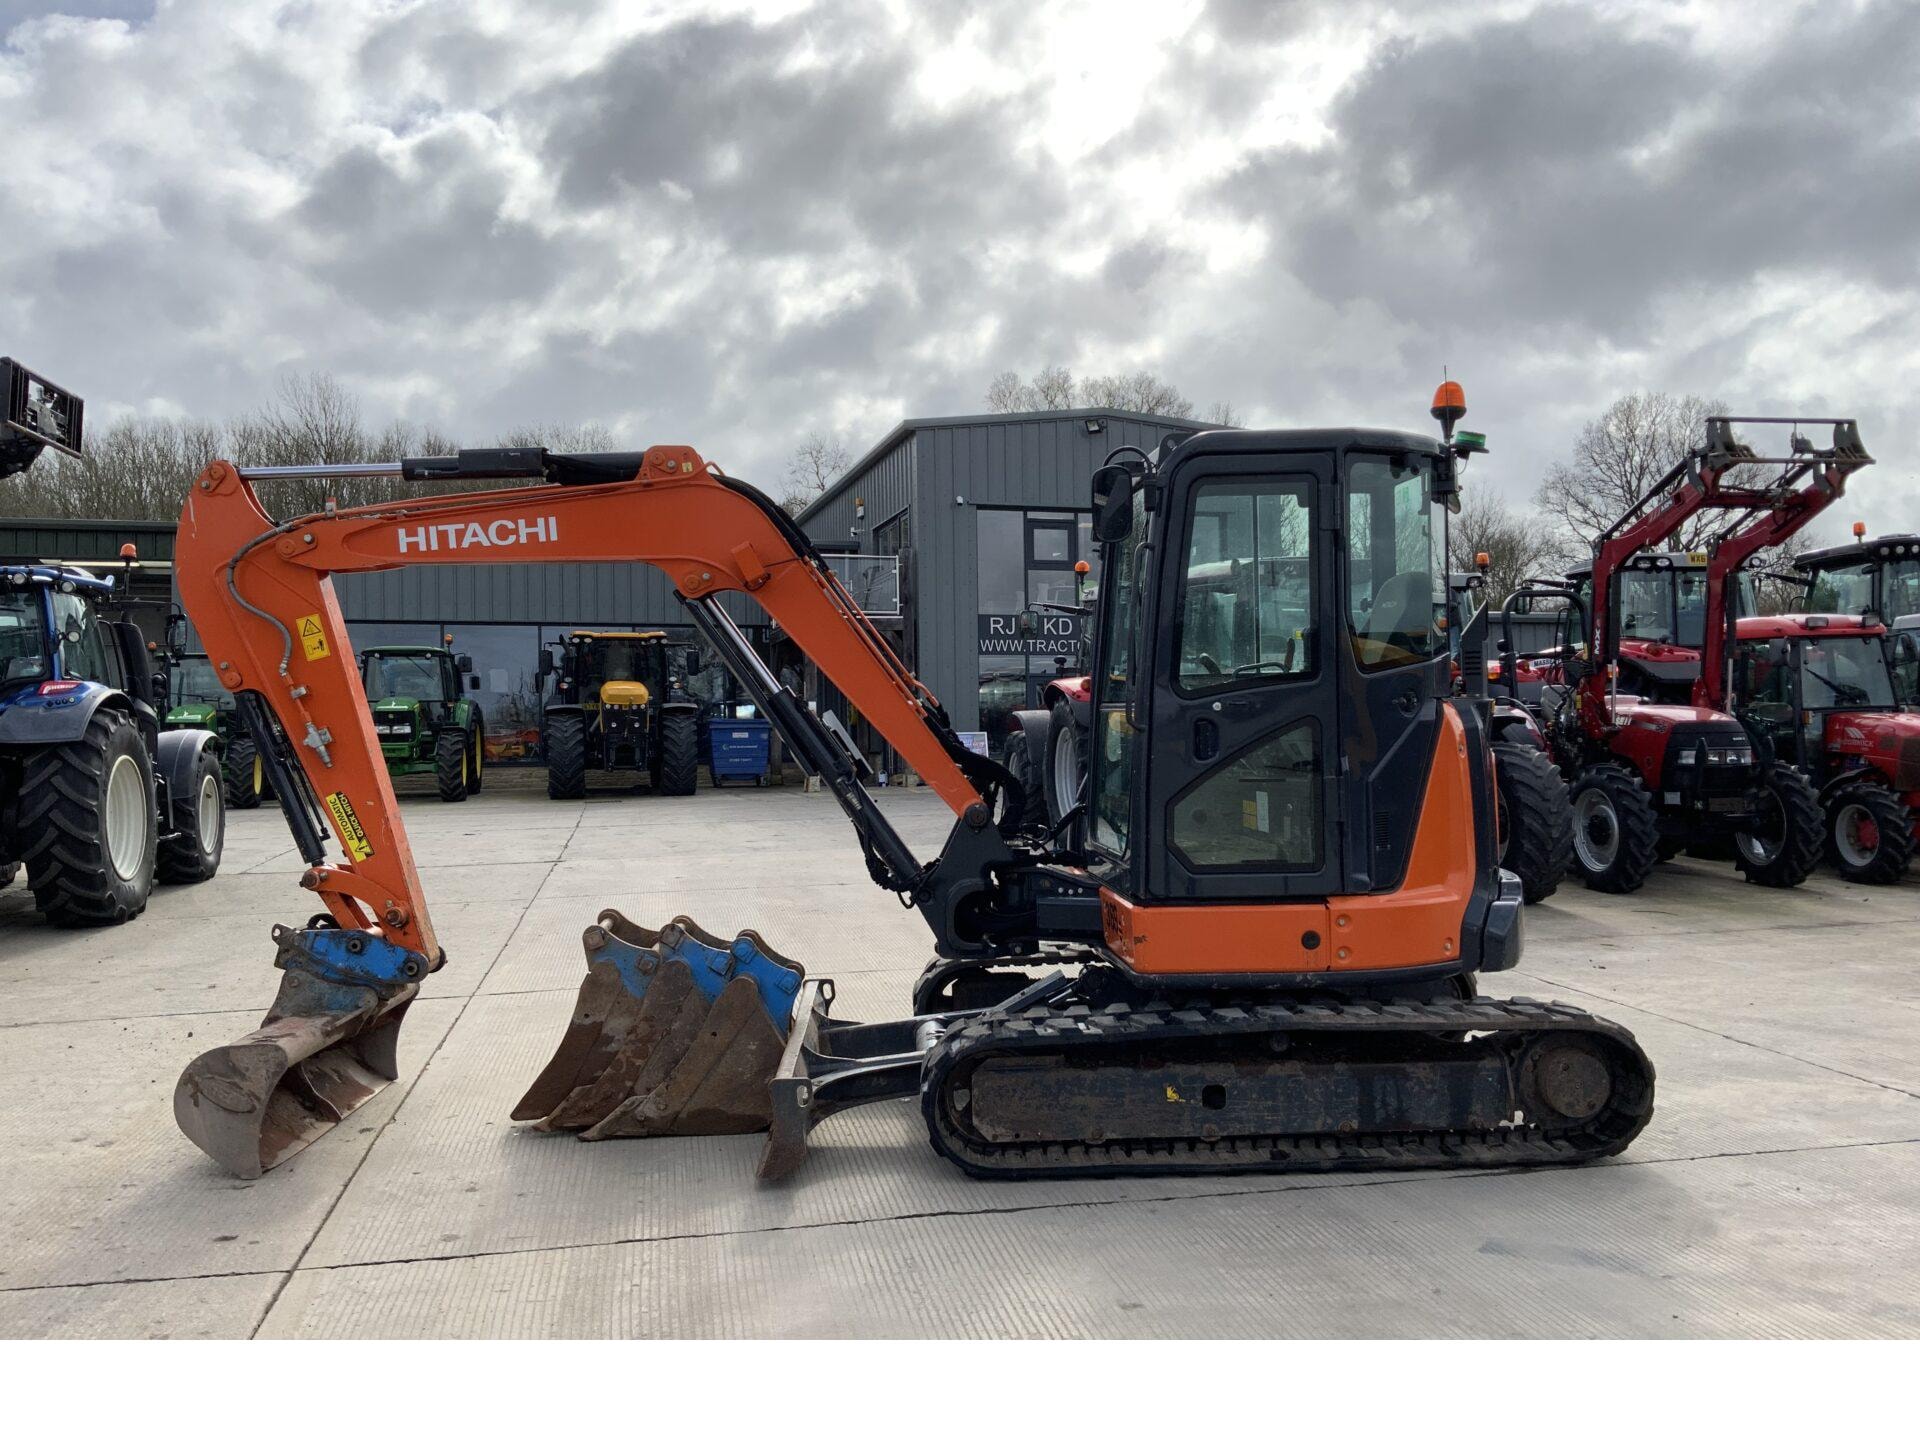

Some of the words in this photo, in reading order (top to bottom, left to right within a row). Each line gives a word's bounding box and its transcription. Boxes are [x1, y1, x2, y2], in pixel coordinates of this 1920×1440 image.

[397, 516, 558, 553] HITACHI
[989, 617, 1016, 635] RJ
[1043, 617, 1073, 635] KD
[980, 639, 1081, 653] WWW.TRACT
[338, 792, 353, 816] HITCH
[329, 797, 355, 841] AUTOMATIC
[349, 814, 364, 837] QUICK
